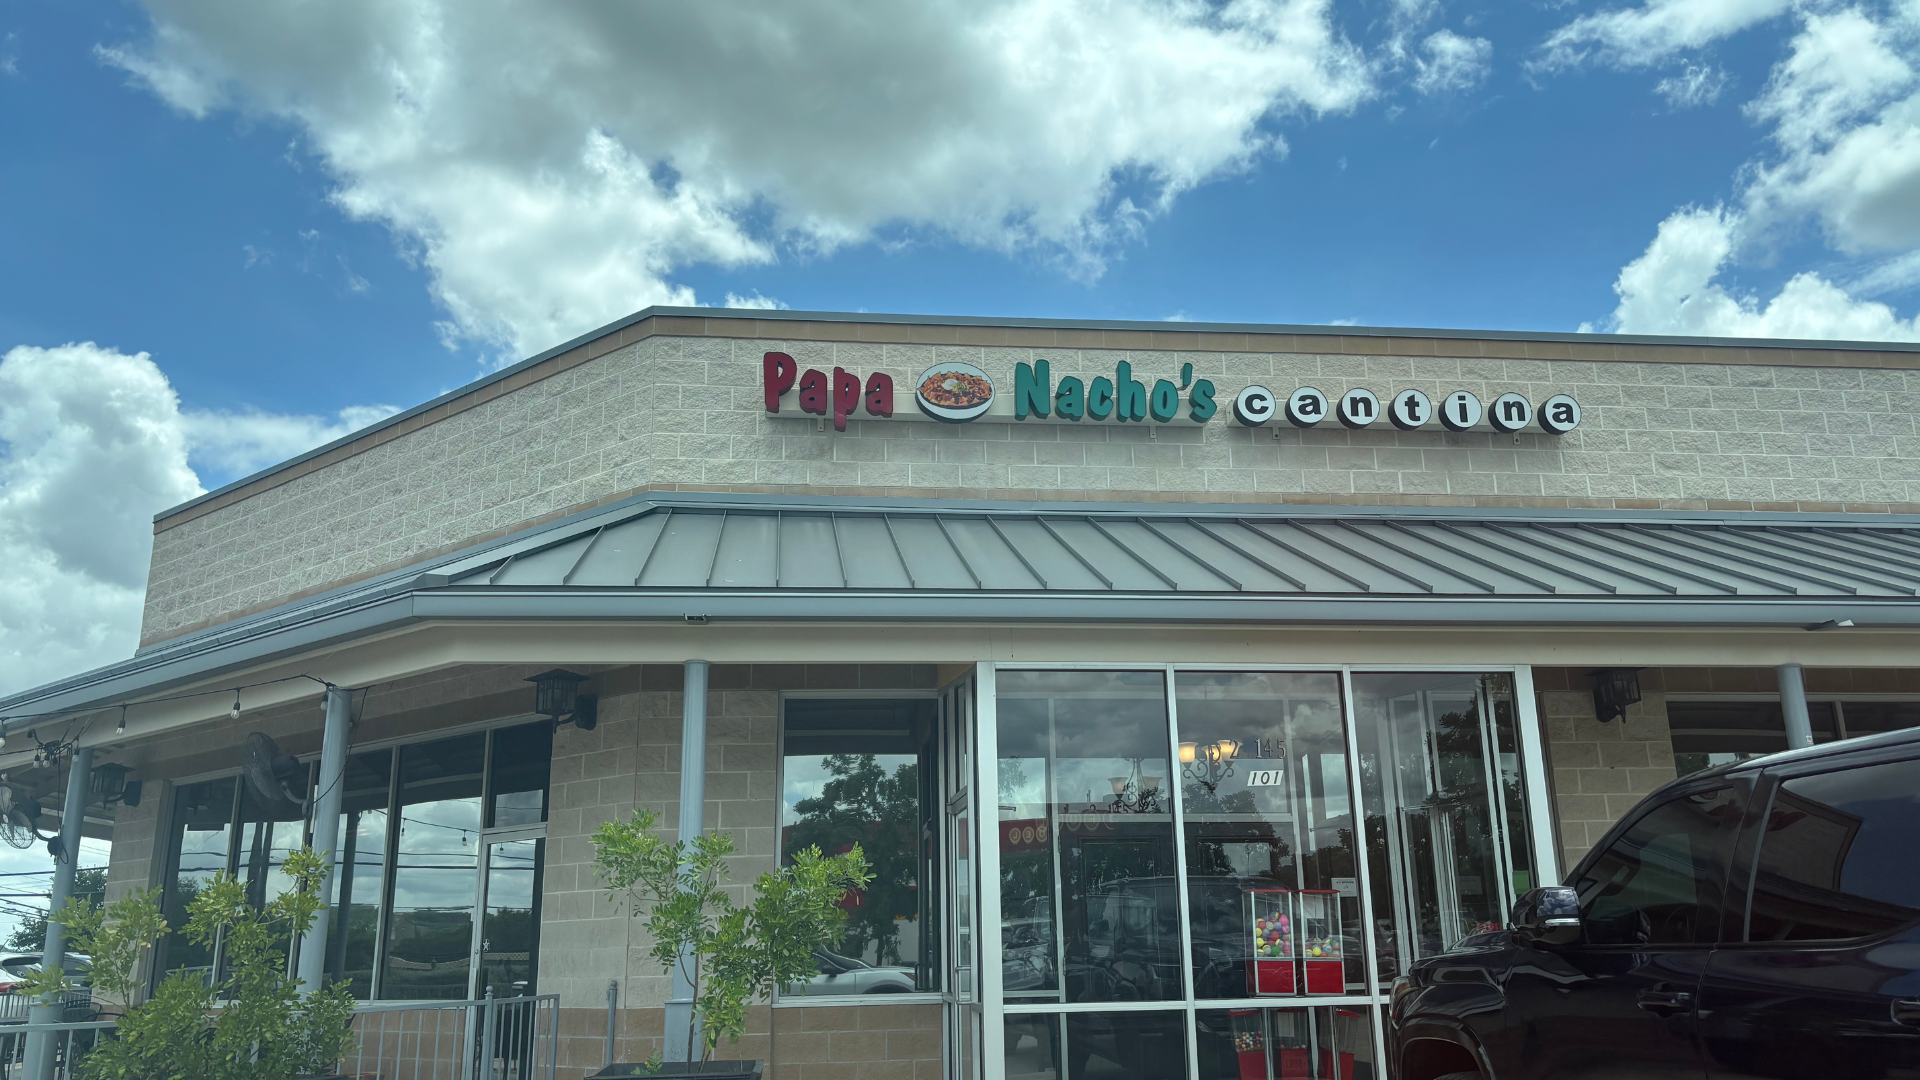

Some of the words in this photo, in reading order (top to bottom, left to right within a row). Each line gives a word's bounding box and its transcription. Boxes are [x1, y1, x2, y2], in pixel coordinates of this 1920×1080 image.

[763, 352, 893, 432] Papa
[1014, 359, 1217, 424] Nacho's
[1242, 391, 1577, 427] cantina
[1251, 770, 1280, 786] 101
